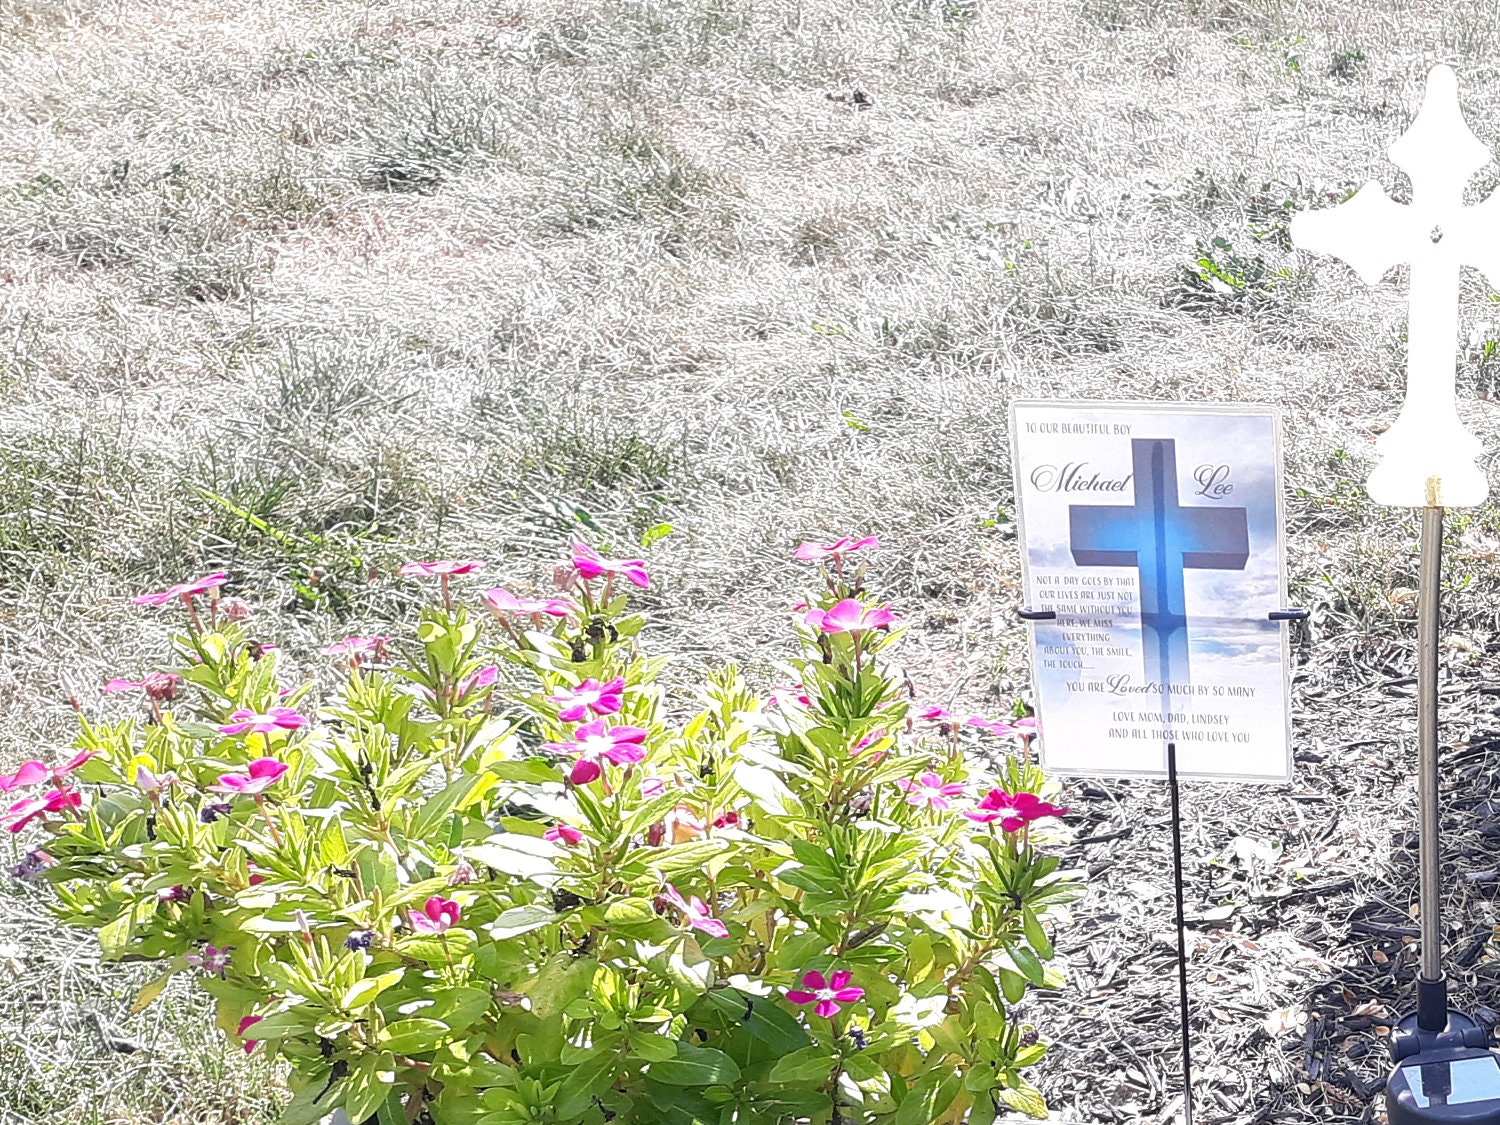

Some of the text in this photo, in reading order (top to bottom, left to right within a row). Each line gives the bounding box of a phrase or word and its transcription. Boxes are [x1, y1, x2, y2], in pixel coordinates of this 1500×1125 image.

[1025, 422, 1132, 435] TO OUR BEAUTIFUL BOY
[1030, 461, 1234, 500] Michael Lee
[1036, 575, 1052, 585] NOT
[1063, 576, 1079, 585] DAY
[1103, 576, 1114, 586] BY
[1116, 577, 1135, 587] THAT
[1039, 589, 1133, 601] OUR LIVES ARE JUST NOT
[1056, 604, 1078, 614] SAME
[1079, 604, 1115, 615] WITHOUT
[1117, 605, 1133, 615] YOU
[1094, 619, 1113, 628] MISS
[1062, 632, 1111, 642] EVERYTHING
[1044, 645, 1069, 655] ABOUT
[1091, 647, 1105, 656] THE
[1043, 659, 1056, 669] THE
[1066, 673, 1256, 698] YOU ARE Loved SO MUCH BY SO MANY
[1112, 711, 1136, 723] LOVE
[1167, 712, 1189, 725] DAD,
[1191, 713, 1230, 726] LINDSEY
[1108, 727, 1250, 744] AND ALL THOSE WHO LOVE YOU
